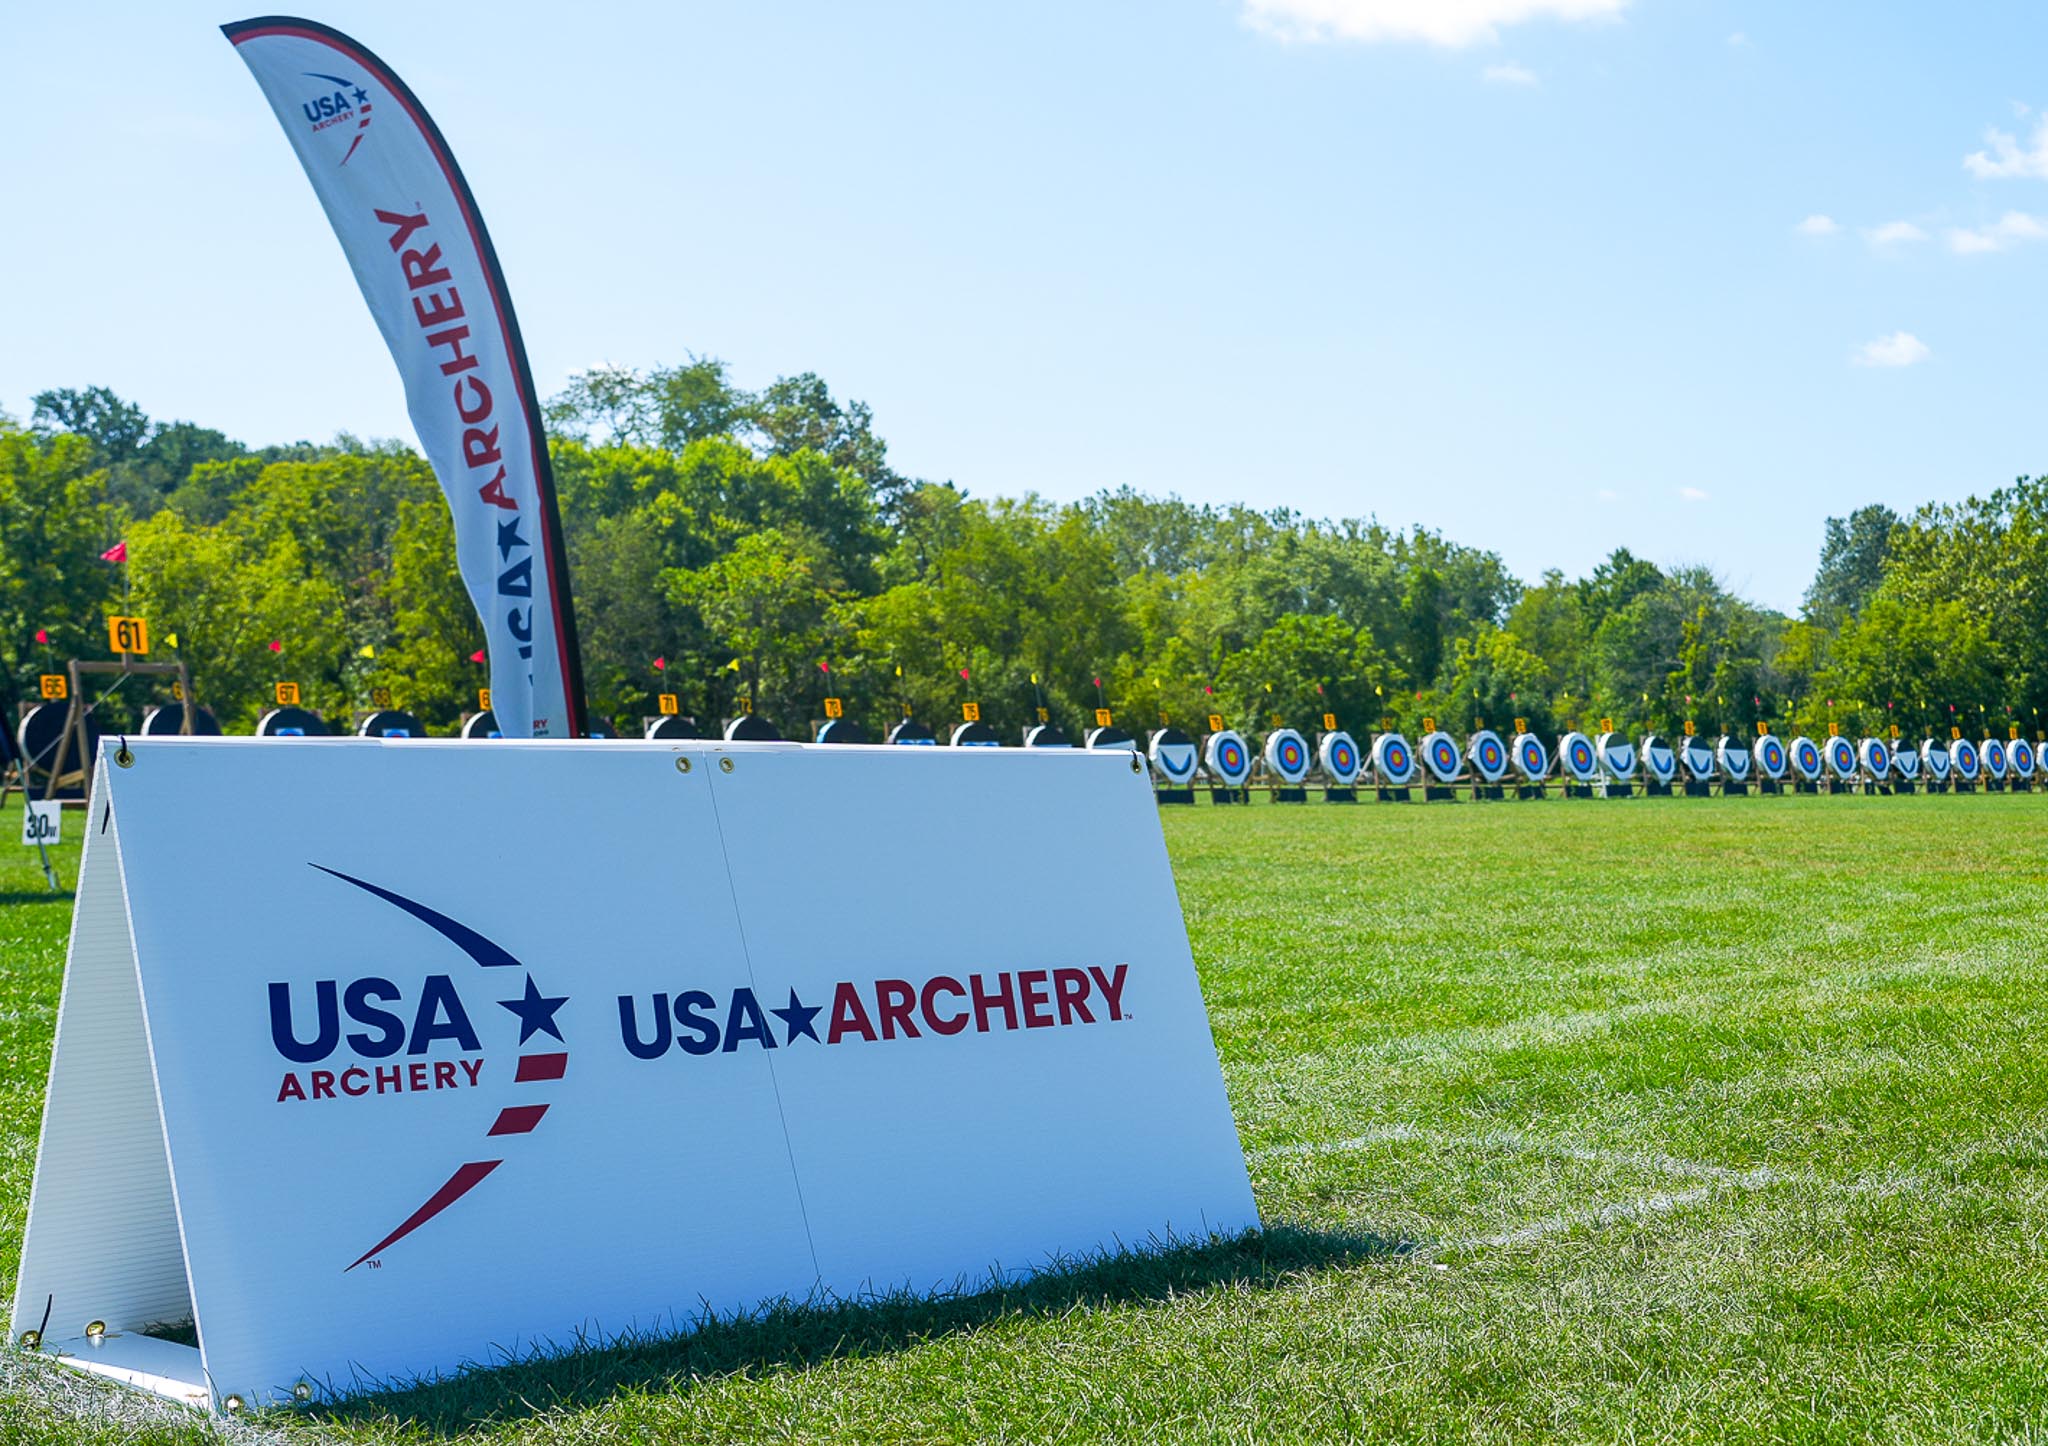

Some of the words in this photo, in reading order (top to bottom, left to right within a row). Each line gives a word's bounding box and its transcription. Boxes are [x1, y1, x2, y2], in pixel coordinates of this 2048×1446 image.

[303, 91, 351, 122] USA
[373, 208, 519, 510] ARCHERY
[117, 620, 141, 650] 61
[45, 678, 63, 695] 65
[279, 685, 294, 703] 67
[268, 975, 483, 1063] USA
[617, 987, 778, 1060] USA
[827, 964, 1128, 1044] ARCHERY
[277, 1058, 484, 1102] ARCHERY
